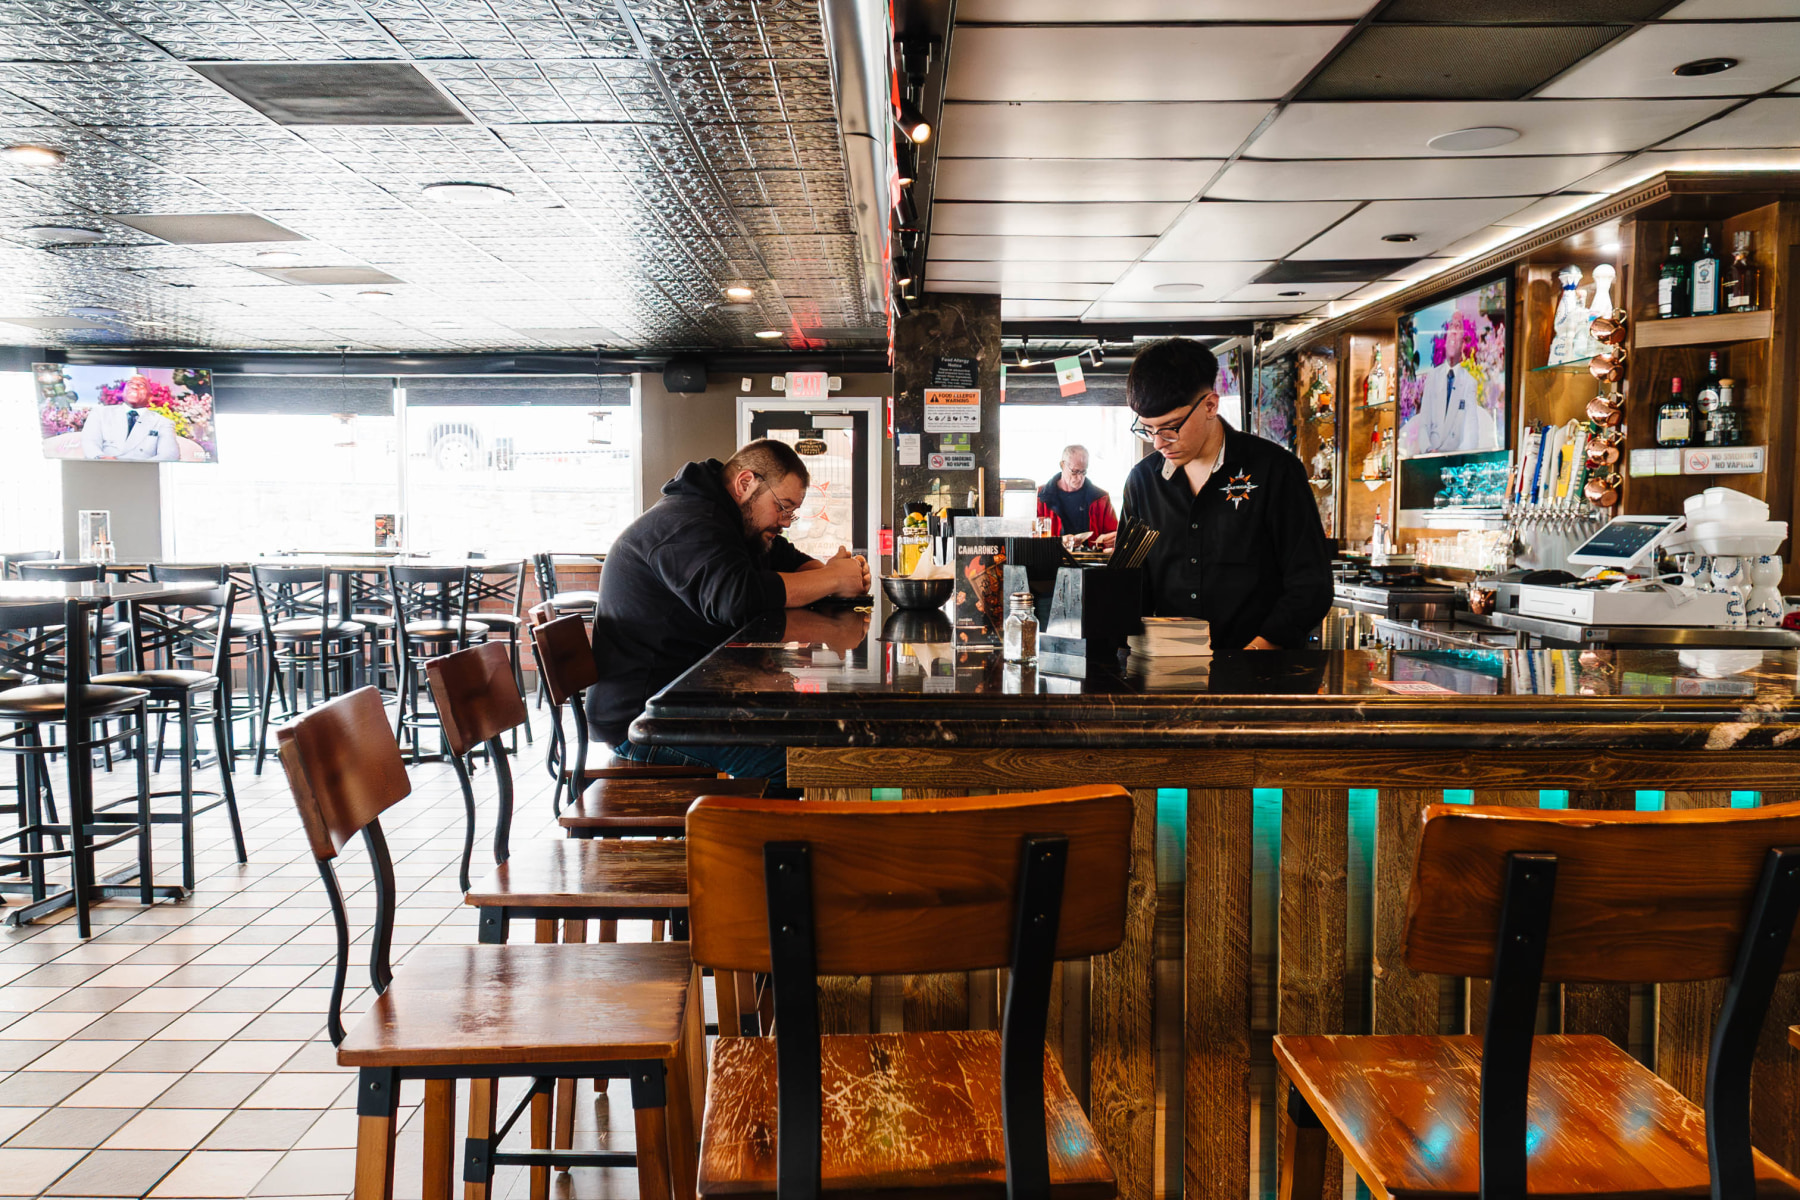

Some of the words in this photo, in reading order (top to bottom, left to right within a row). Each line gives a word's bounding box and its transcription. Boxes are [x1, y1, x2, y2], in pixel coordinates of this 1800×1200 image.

[793, 374, 823, 397] EXIT
[1723, 452, 1758, 460] SMOKING
[1715, 461, 1725, 469] NO
[1726, 461, 1754, 469] VAPING
[958, 545, 999, 555] CAMARONES
